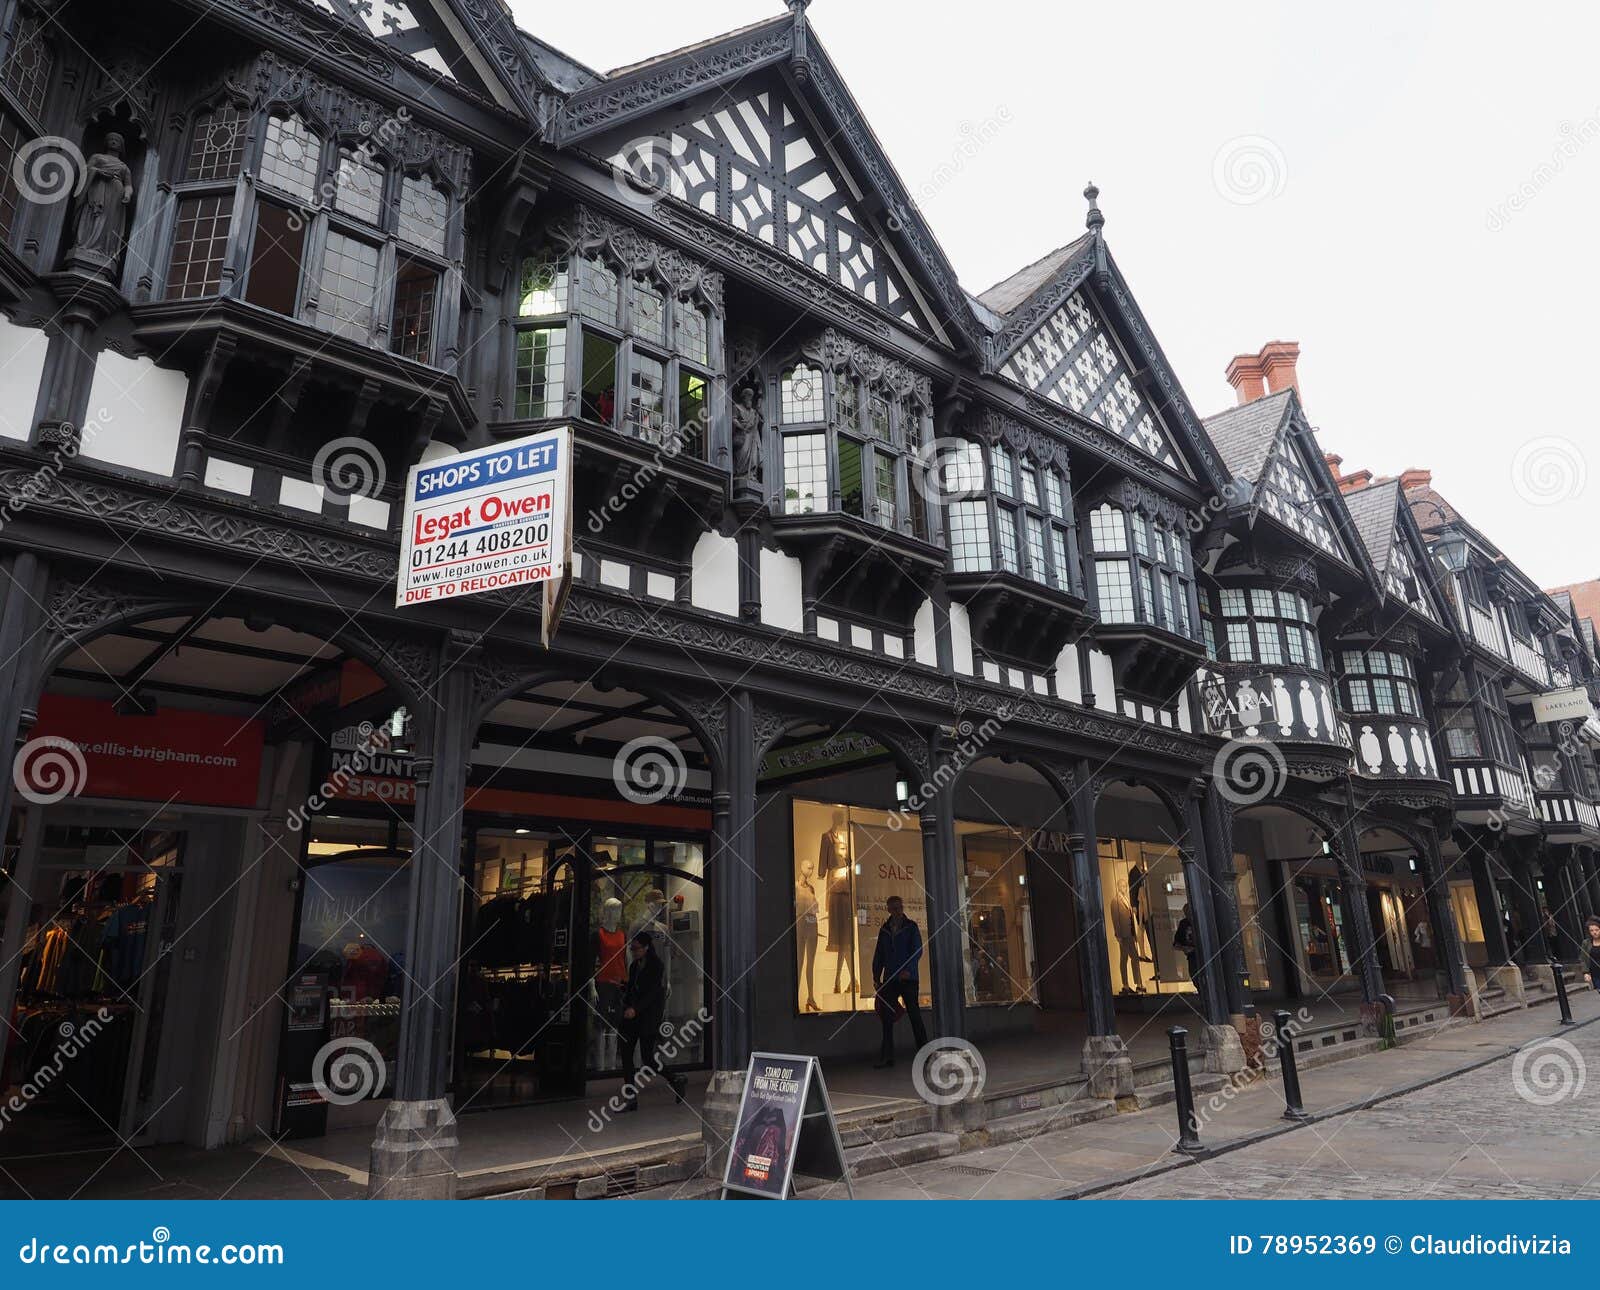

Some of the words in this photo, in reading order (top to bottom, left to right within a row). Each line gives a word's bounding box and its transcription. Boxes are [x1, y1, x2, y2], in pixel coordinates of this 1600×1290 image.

[419, 462, 480, 493] SHOPS
[486, 456, 512, 477] TO
[517, 445, 554, 470] LET
[414, 505, 471, 545] Legat
[480, 493, 551, 522] Owen
[412, 539, 469, 567] 01244
[476, 523, 549, 554] 408200
[412, 548, 548, 584] www.legatowen.co.uk
[405, 587, 432, 602] DUE
[437, 583, 456, 597] TO
[460, 565, 551, 592] RELOCATION
[1209, 691, 1273, 717] ZARA
[1544, 699, 1584, 711] LAKELAND
[45, 737, 237, 767] www.ellis-brigham.com
[332, 752, 417, 777] MOUNT
[347, 777, 417, 800] SPORT
[1037, 831, 1073, 854] ZAR
[878, 863, 914, 881] SALE
[781, 1068, 793, 1080] OUT
[779, 1081, 799, 1094] CROWD
